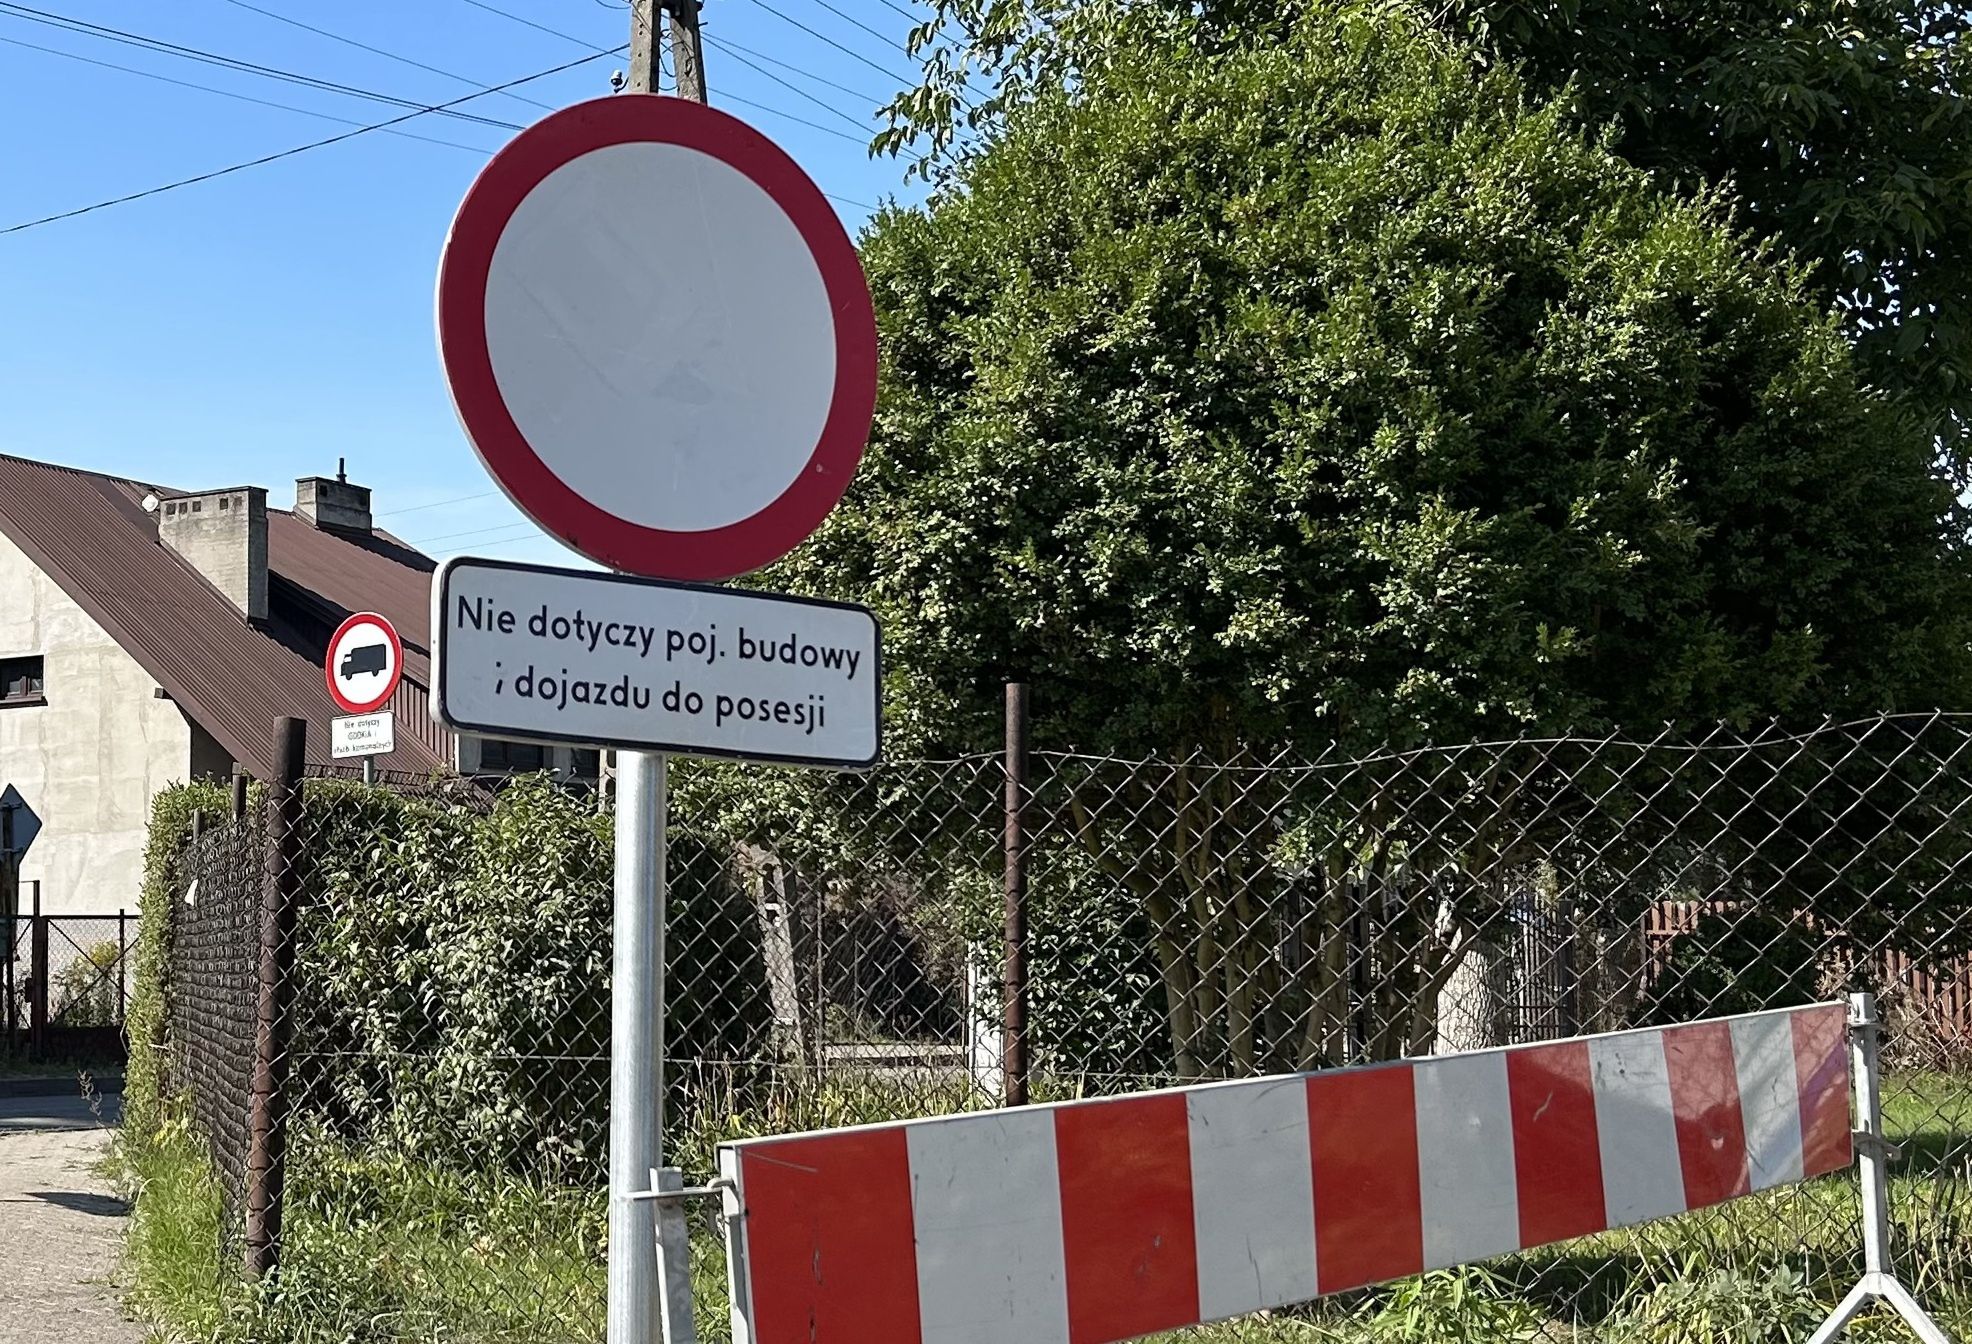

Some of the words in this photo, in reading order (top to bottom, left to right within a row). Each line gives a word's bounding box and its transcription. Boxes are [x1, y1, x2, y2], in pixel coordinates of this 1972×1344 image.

[457, 594, 516, 635] Nie
[527, 604, 655, 659] dotyczy
[666, 623, 726, 666] poj.
[738, 626, 861, 681] budowy
[495, 660, 504, 696] i
[514, 664, 651, 712] dojazdu
[661, 679, 704, 715] do
[715, 693, 825, 736] posesji
